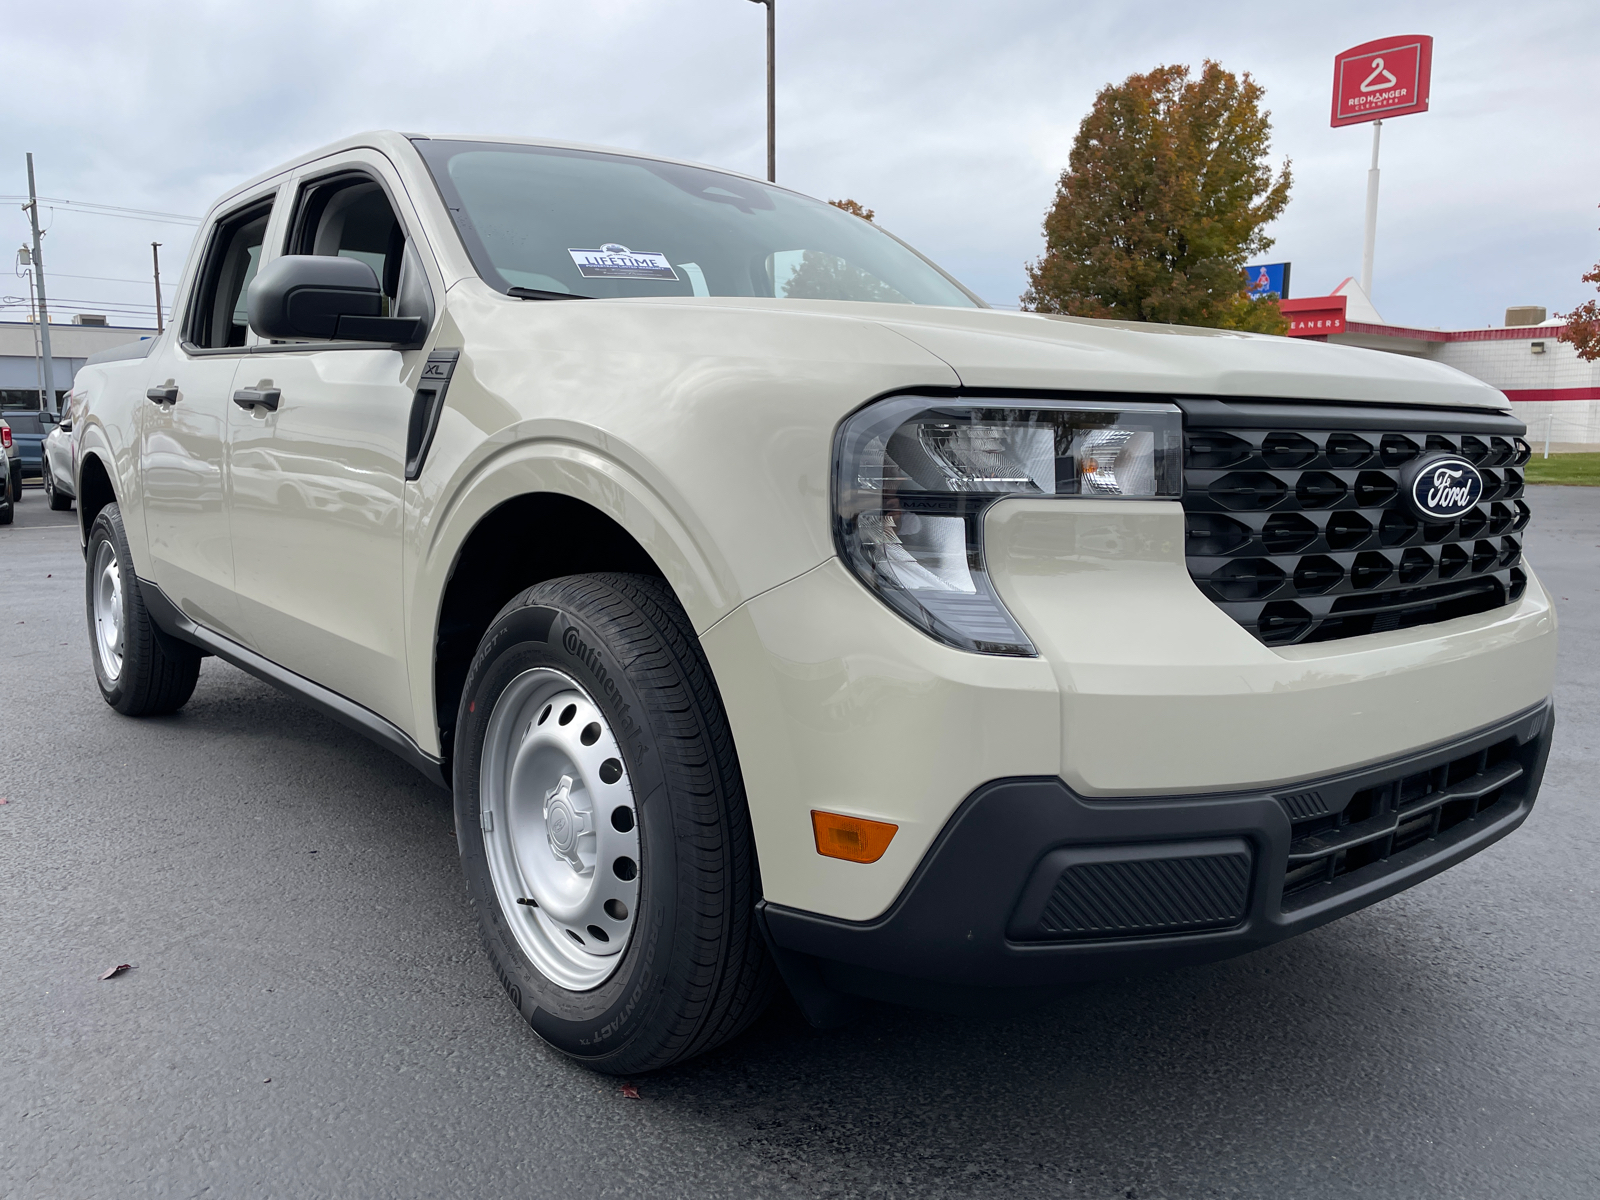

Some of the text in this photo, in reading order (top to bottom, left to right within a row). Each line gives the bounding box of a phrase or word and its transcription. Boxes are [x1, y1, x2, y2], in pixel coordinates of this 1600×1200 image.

[1349, 88, 1407, 106] RED HANGER
[1355, 98, 1398, 110] CLEANERS
[584, 256, 660, 267] LIFETIME
[1290, 319, 1340, 329] EANERS
[425, 364, 444, 375] XL
[1428, 468, 1472, 508] Ford
[903, 501, 981, 510] MAVERCK
[562, 625, 643, 740] Continental
